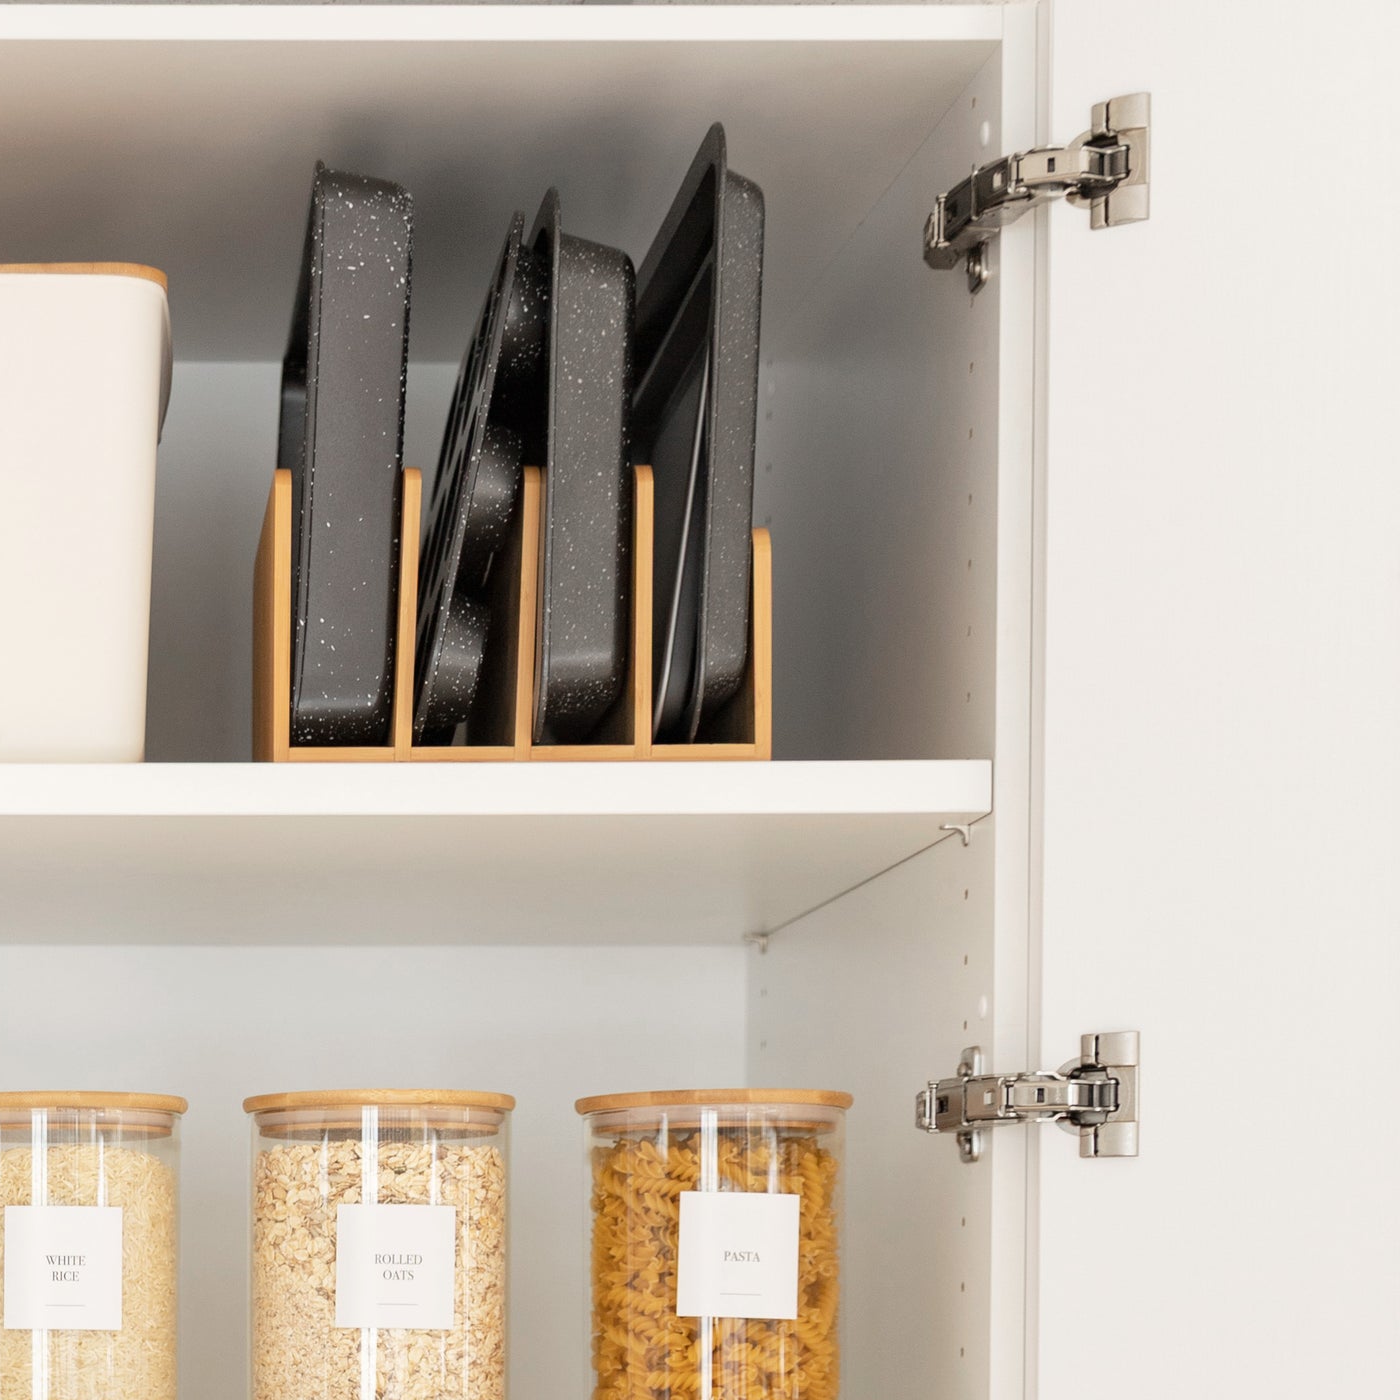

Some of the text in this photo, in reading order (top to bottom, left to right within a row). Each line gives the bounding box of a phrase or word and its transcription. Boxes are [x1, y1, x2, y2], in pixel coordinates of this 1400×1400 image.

[46, 1255, 86, 1266] WHITE
[374, 1253, 423, 1265] ROLLED
[723, 1250, 761, 1263] PASTA
[52, 1271, 80, 1282] RICE
[382, 1269, 415, 1281] OATS
